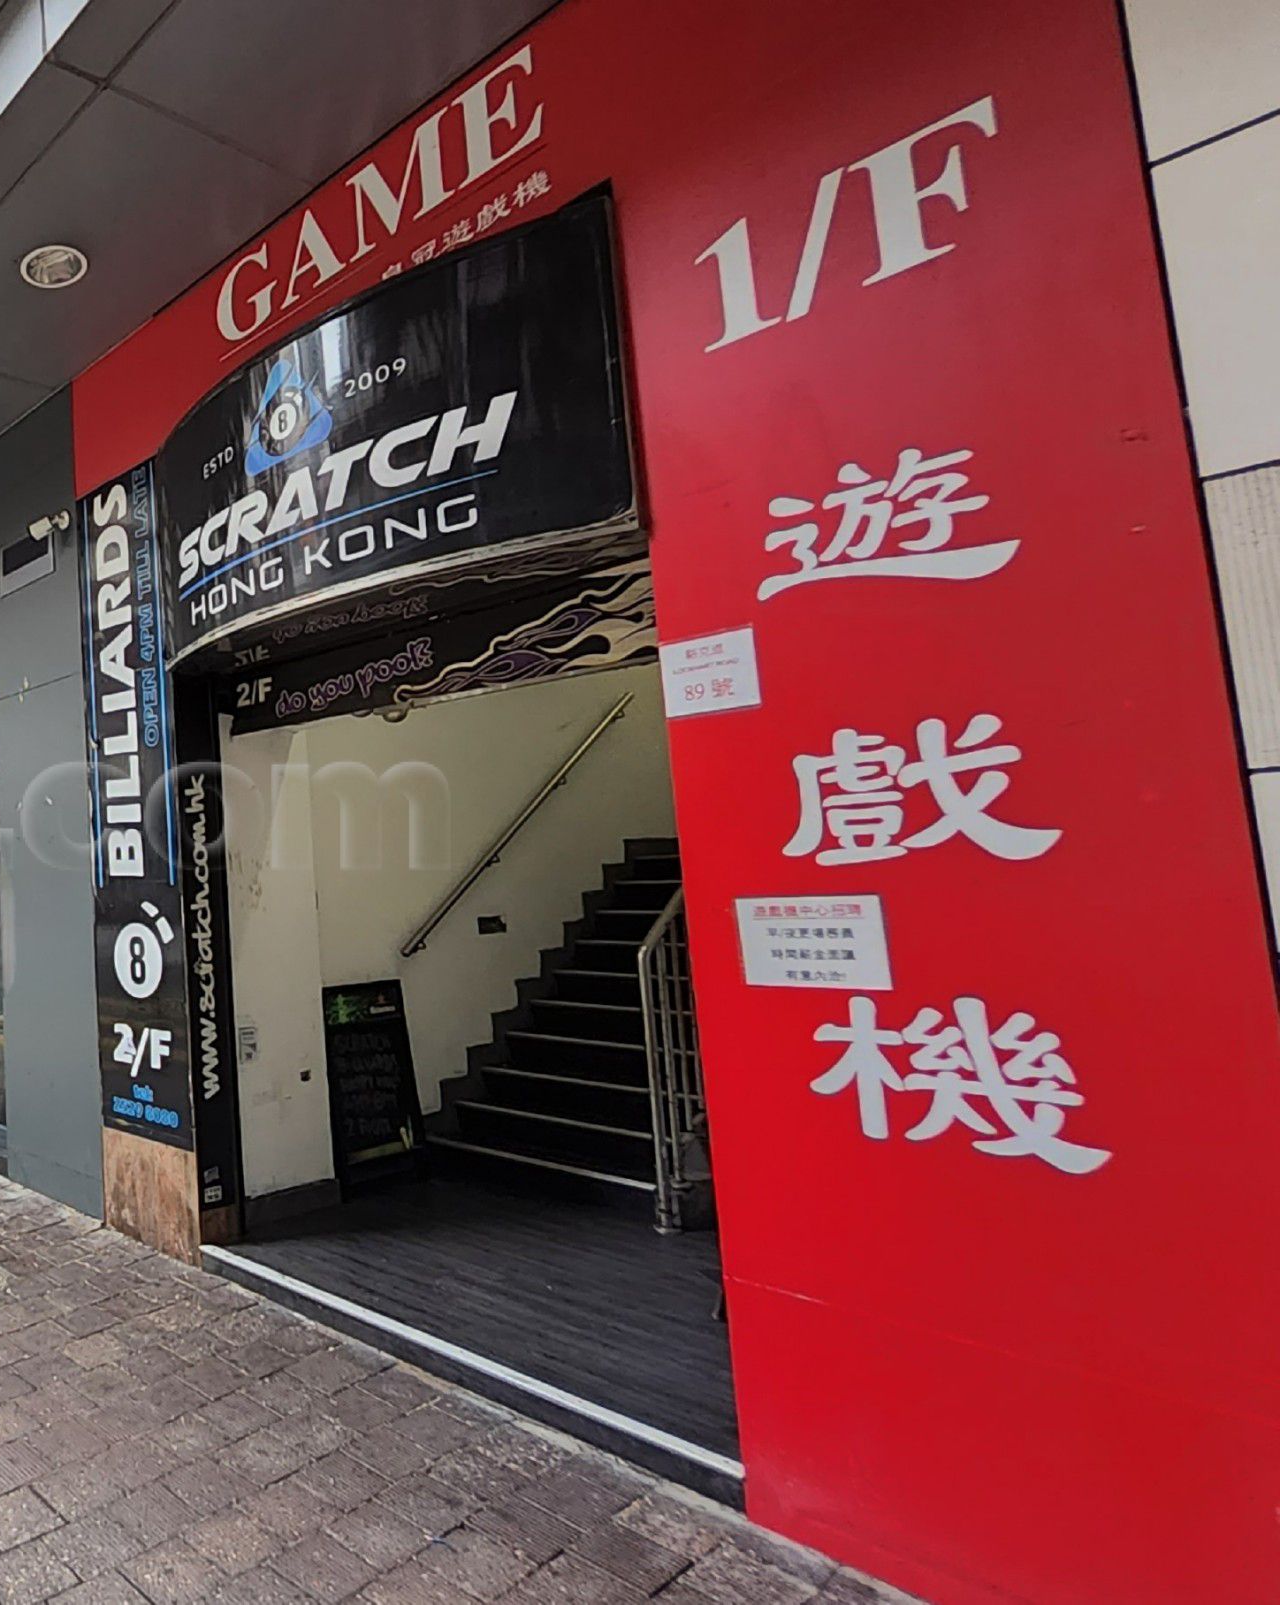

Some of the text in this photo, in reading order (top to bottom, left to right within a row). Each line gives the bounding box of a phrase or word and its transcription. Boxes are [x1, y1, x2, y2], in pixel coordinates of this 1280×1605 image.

[216, 44, 546, 343] GAME
[695, 95, 998, 353] 1/F
[179, 390, 519, 589] SCRATCH
[202, 356, 408, 480] ESTD 2009
[131, 466, 160, 748] OPEN 4PM TILL LATE
[190, 493, 479, 626] HONG KONG
[94, 483, 145, 878] BILLIARDS
[236, 677, 273, 708] 2/F
[275, 690, 307, 718] do
[308, 673, 355, 711] you
[684, 683, 705, 701] 89
[129, 936, 147, 985] 8
[184, 773, 221, 1101] www.scratch.com.hk
[113, 1023, 172, 1078] 2/F
